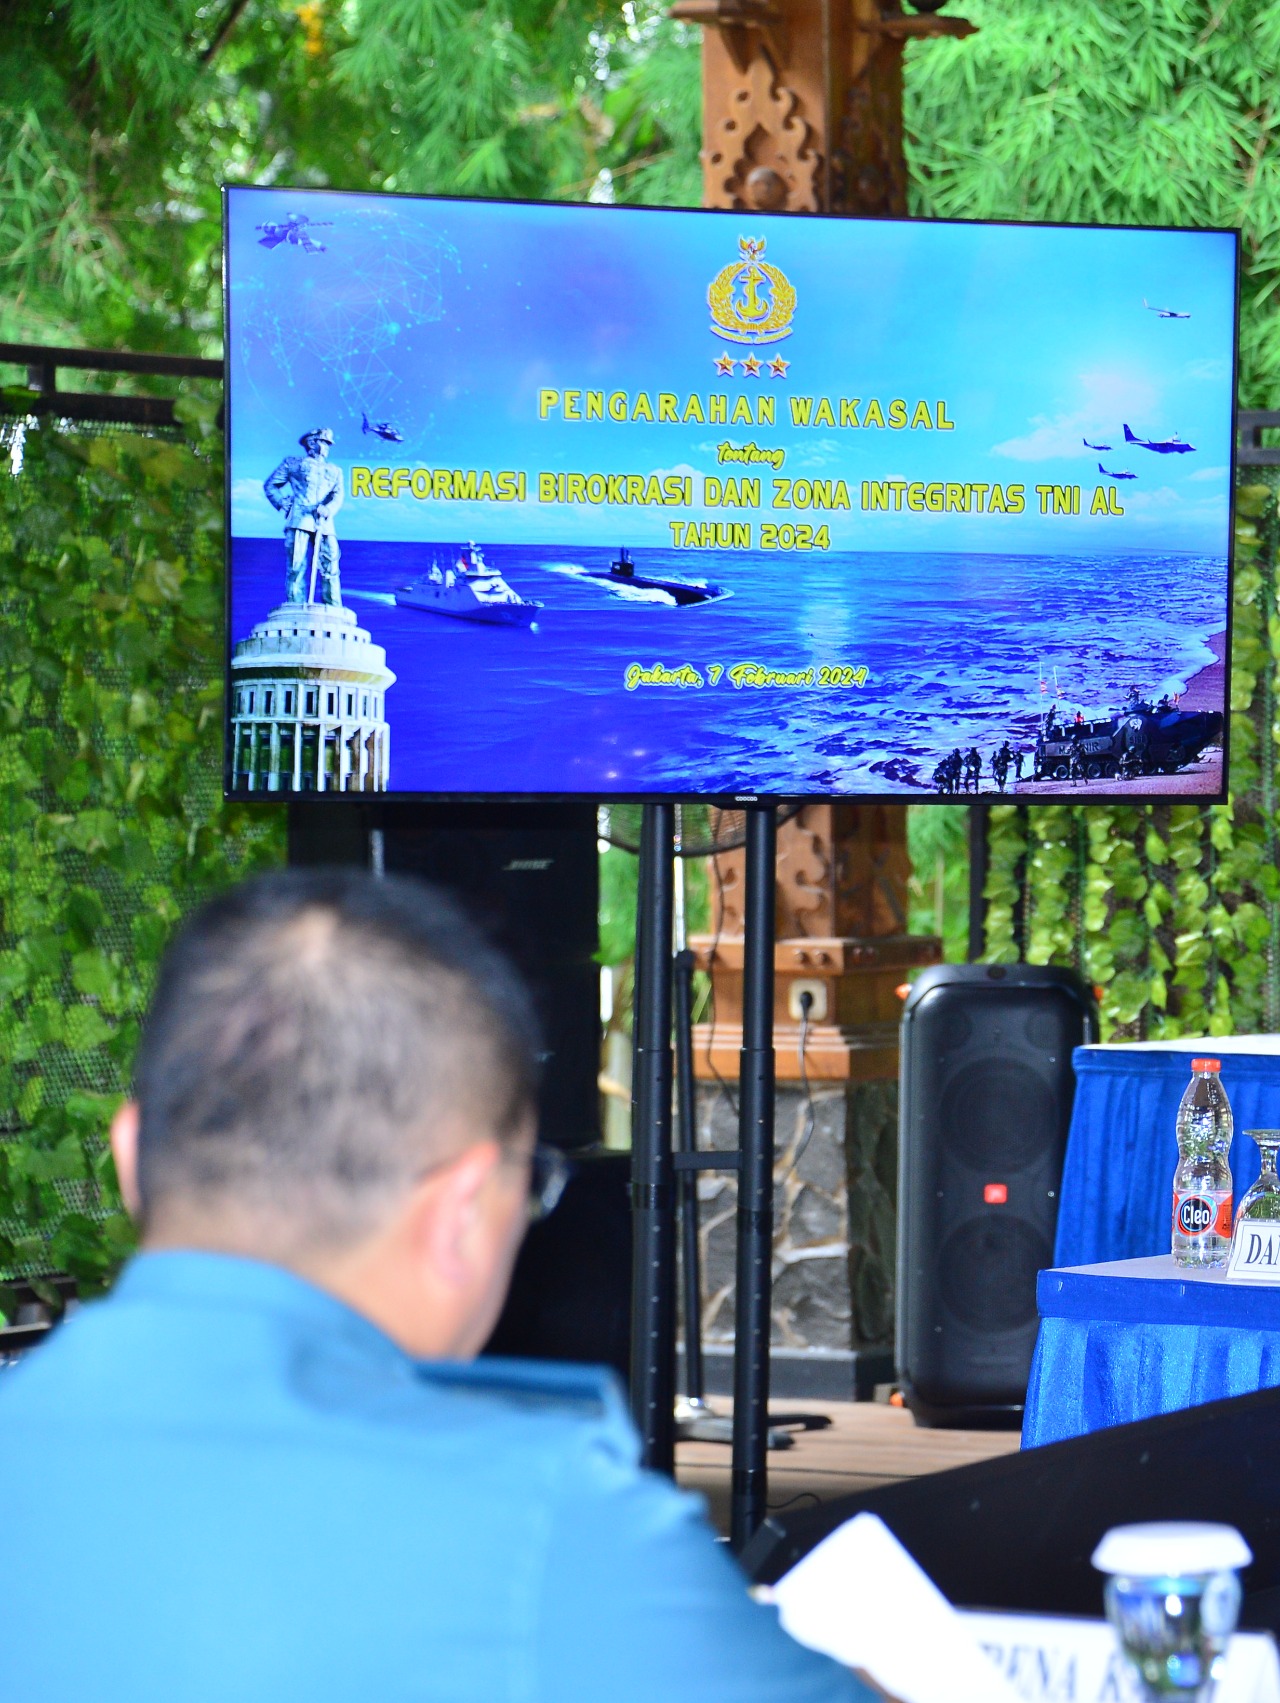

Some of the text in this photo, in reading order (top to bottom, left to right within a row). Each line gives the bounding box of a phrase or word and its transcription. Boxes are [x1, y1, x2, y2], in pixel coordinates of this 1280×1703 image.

[539, 389, 956, 430] PENGARAHAN WAKASAL
[351, 467, 1125, 516] REFORMASI BIROKRASI DAN ZONA INTEGRITAS TNI AL
[669, 521, 831, 551] TAHUN 2024
[627, 663, 868, 689] Jakarta, 7 Februari 2024
[1183, 1205, 1210, 1225] Cleo
